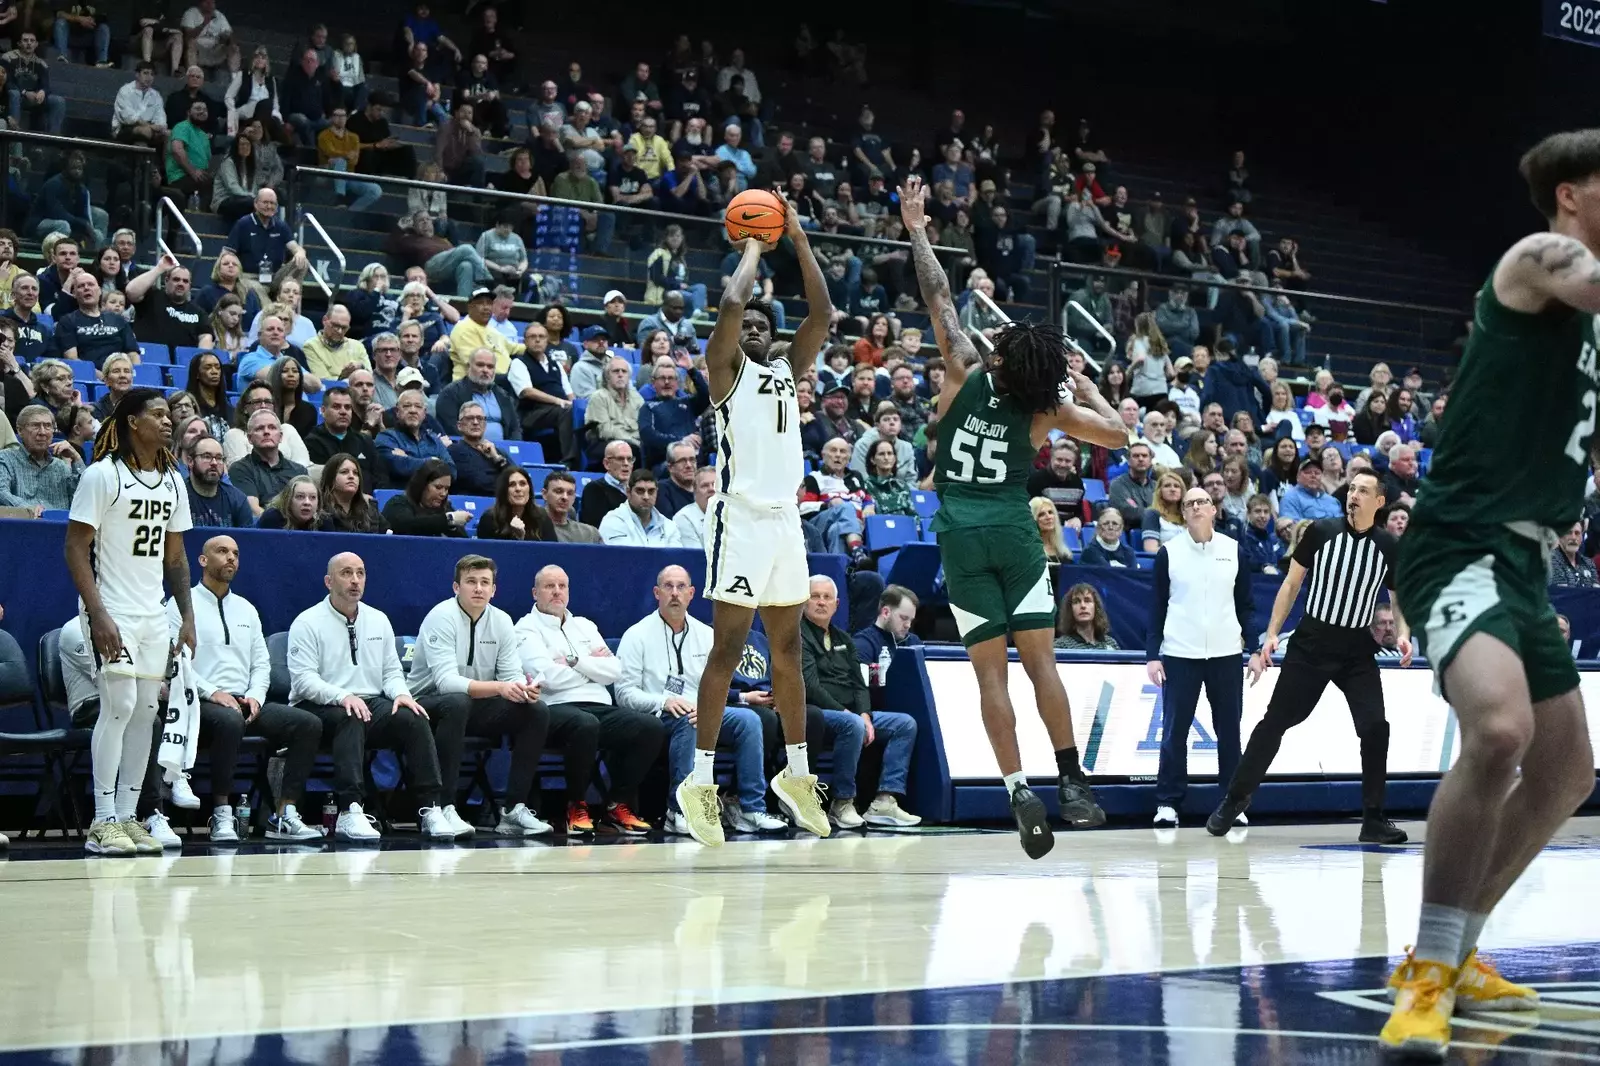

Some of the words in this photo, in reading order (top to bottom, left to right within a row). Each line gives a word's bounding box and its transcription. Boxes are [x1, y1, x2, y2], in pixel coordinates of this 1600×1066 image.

[987, 395, 1000, 409] E
[777, 399, 788, 433] 11
[963, 413, 1009, 439] LOVEJOY
[946, 427, 1009, 484] 55
[128, 499, 172, 521] ZIPS
[132, 525, 163, 557] 22
[725, 575, 754, 597] A
[1441, 600, 1467, 628] E
